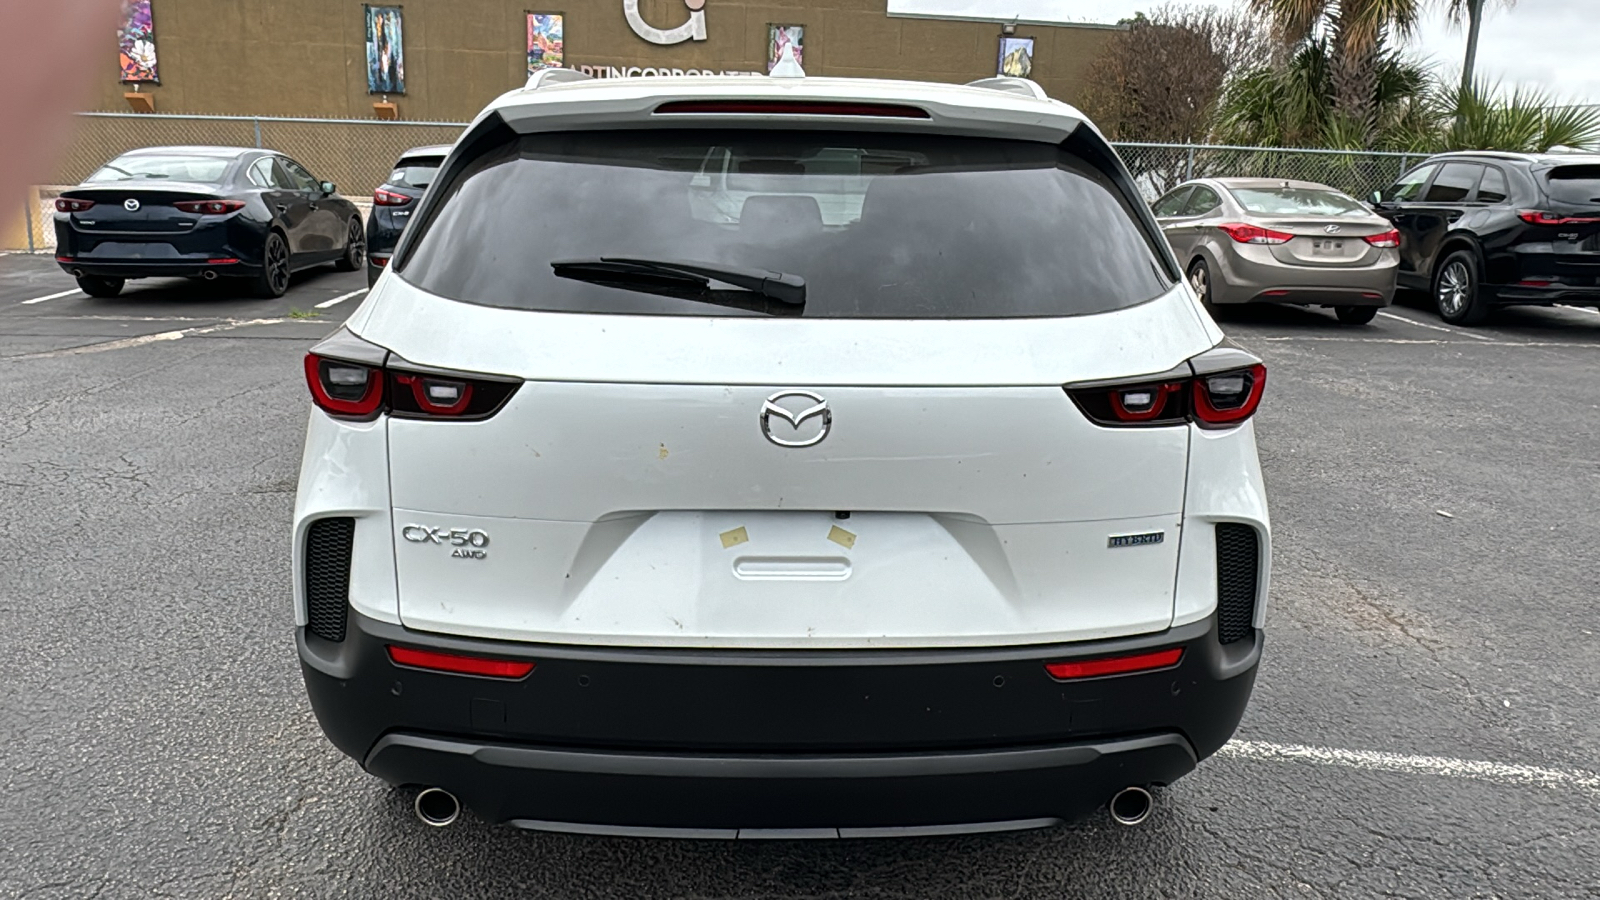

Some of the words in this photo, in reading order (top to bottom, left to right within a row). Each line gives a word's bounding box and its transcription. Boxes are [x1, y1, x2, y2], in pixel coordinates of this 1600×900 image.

[570, 64, 762, 79] RTINCORP
[402, 523, 490, 548] CX-50
[1110, 531, 1164, 547] HYBRID
[451, 548, 487, 560] AWD
